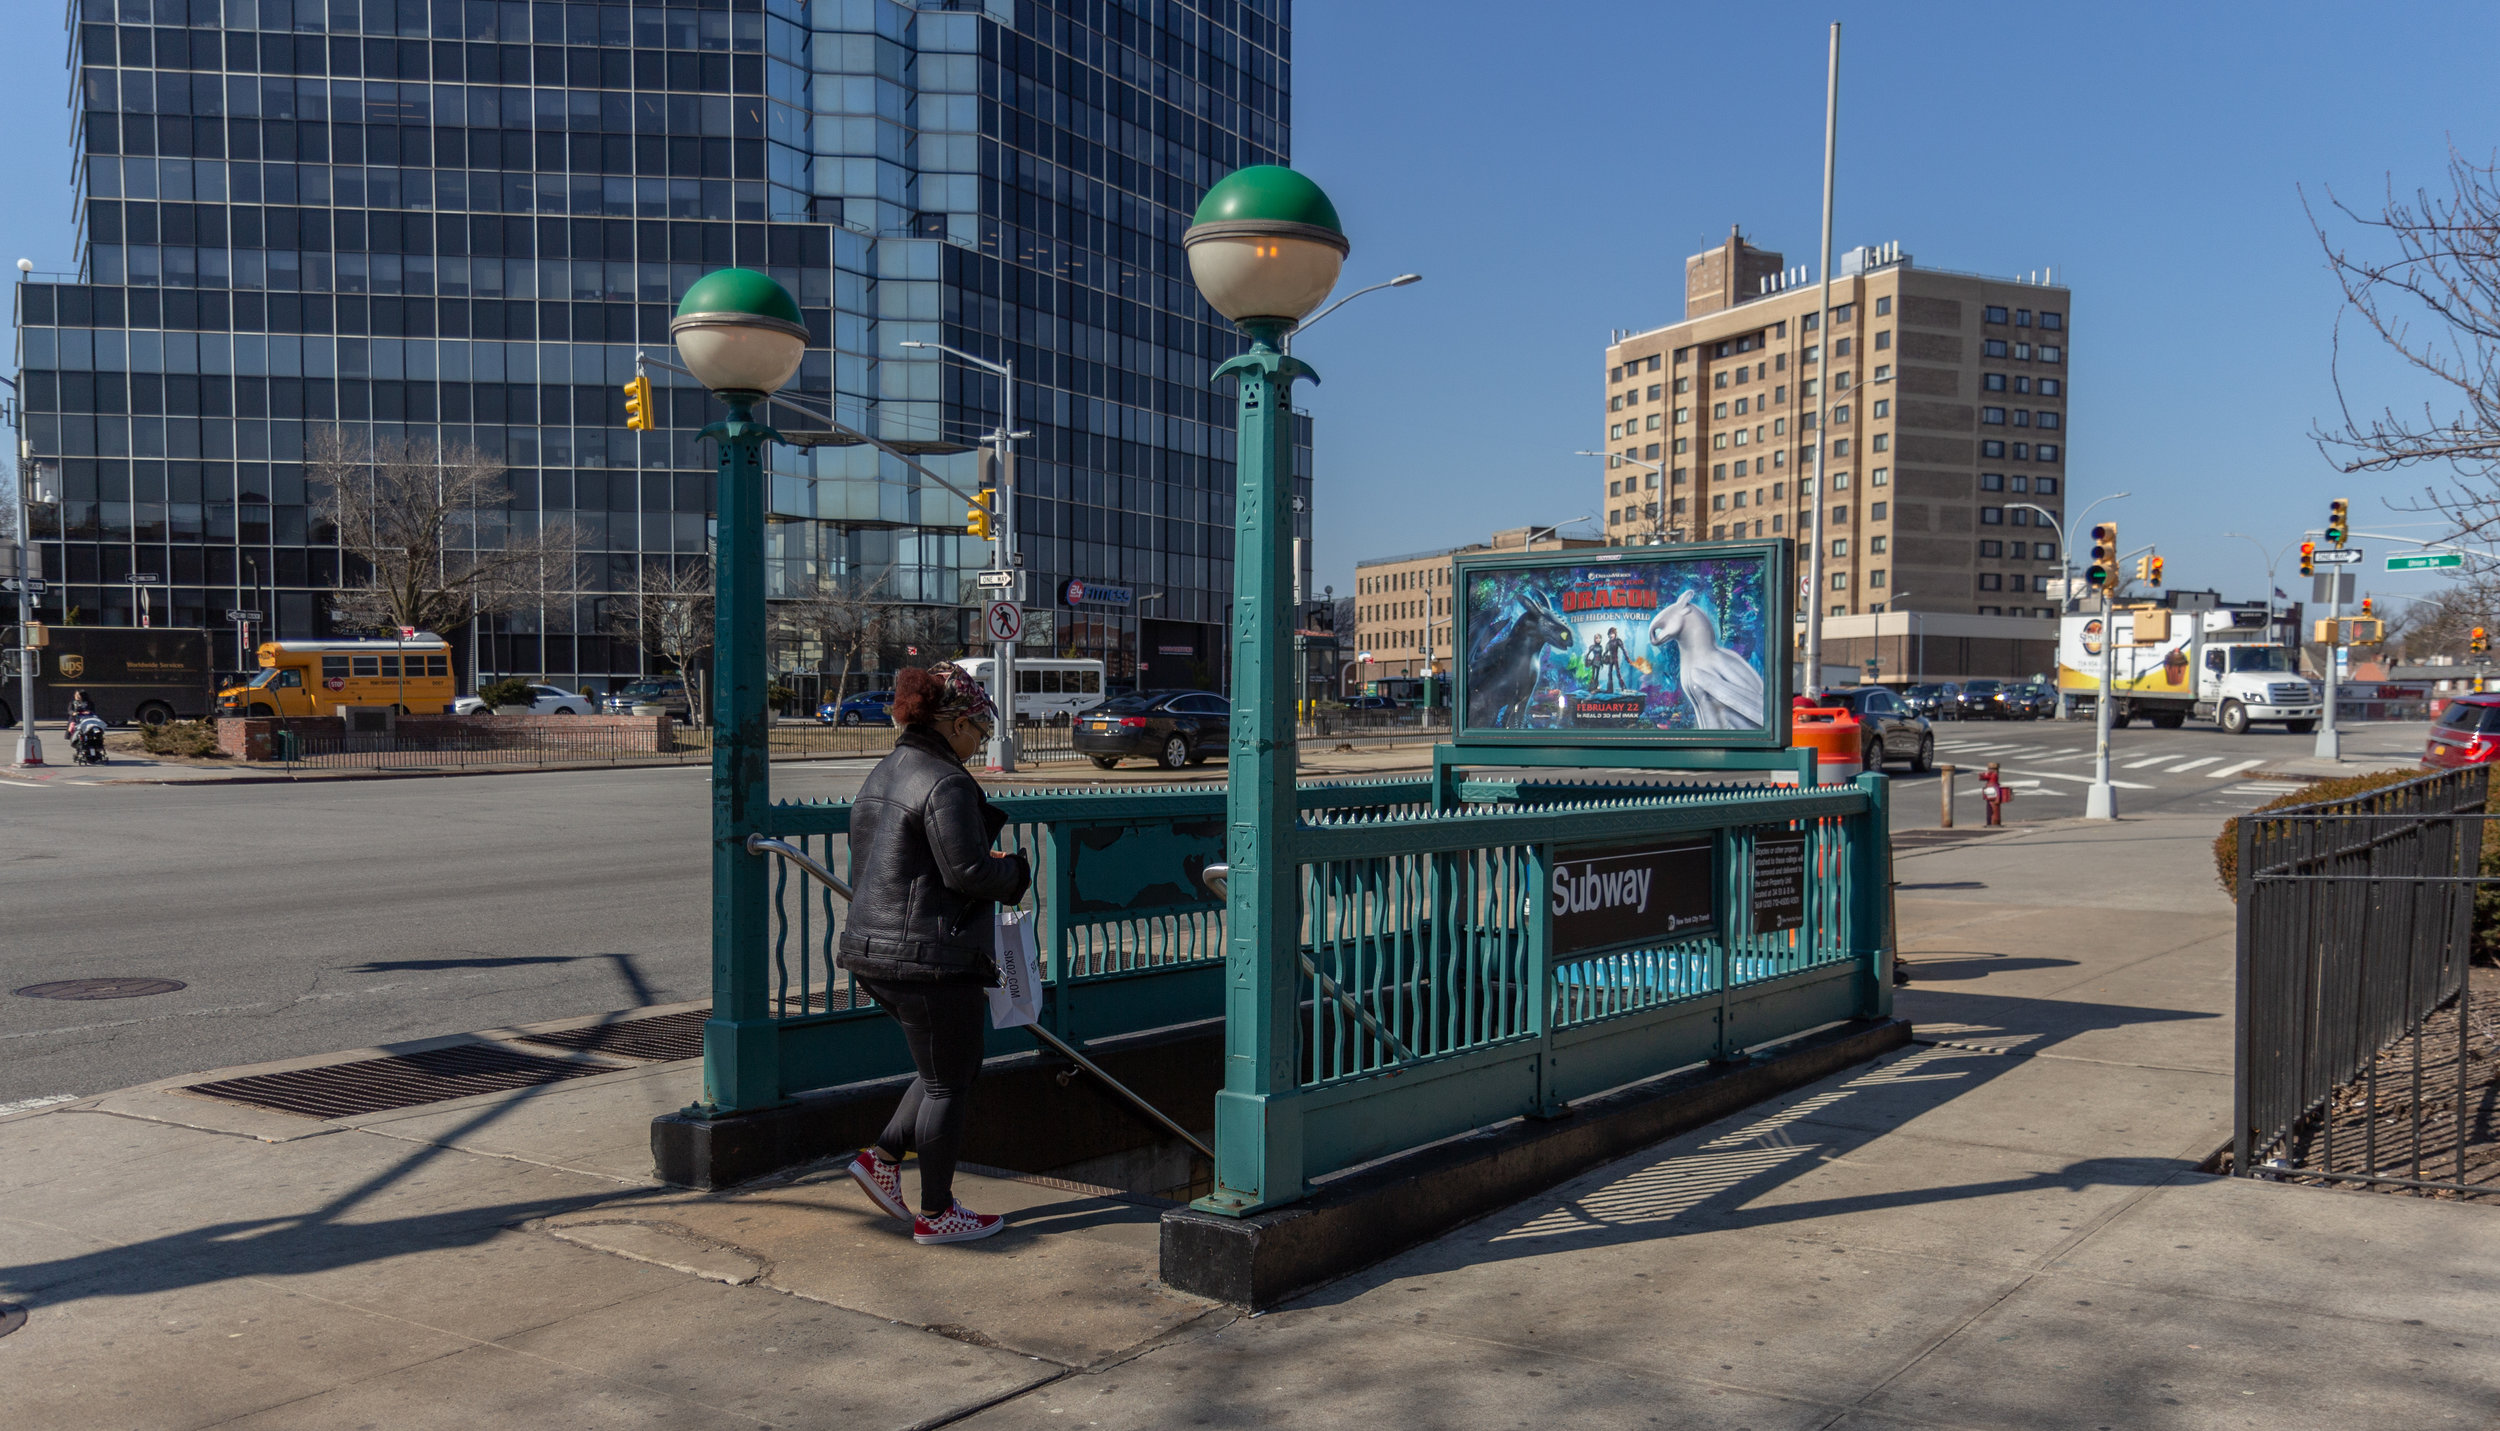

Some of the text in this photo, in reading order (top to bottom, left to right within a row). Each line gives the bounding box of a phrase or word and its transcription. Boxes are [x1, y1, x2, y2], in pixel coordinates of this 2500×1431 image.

[997, 575, 1008, 583] WAY
[1071, 584, 1131, 602] 24 FITNESS
[1562, 589, 1657, 612] DRAGON
[1570, 612, 1651, 623] THE HIDDEN WORLD
[62, 661, 82, 675] ups
[1577, 703, 1639, 712] FEBRUARY 22
[1552, 864, 1651, 916] Subway
